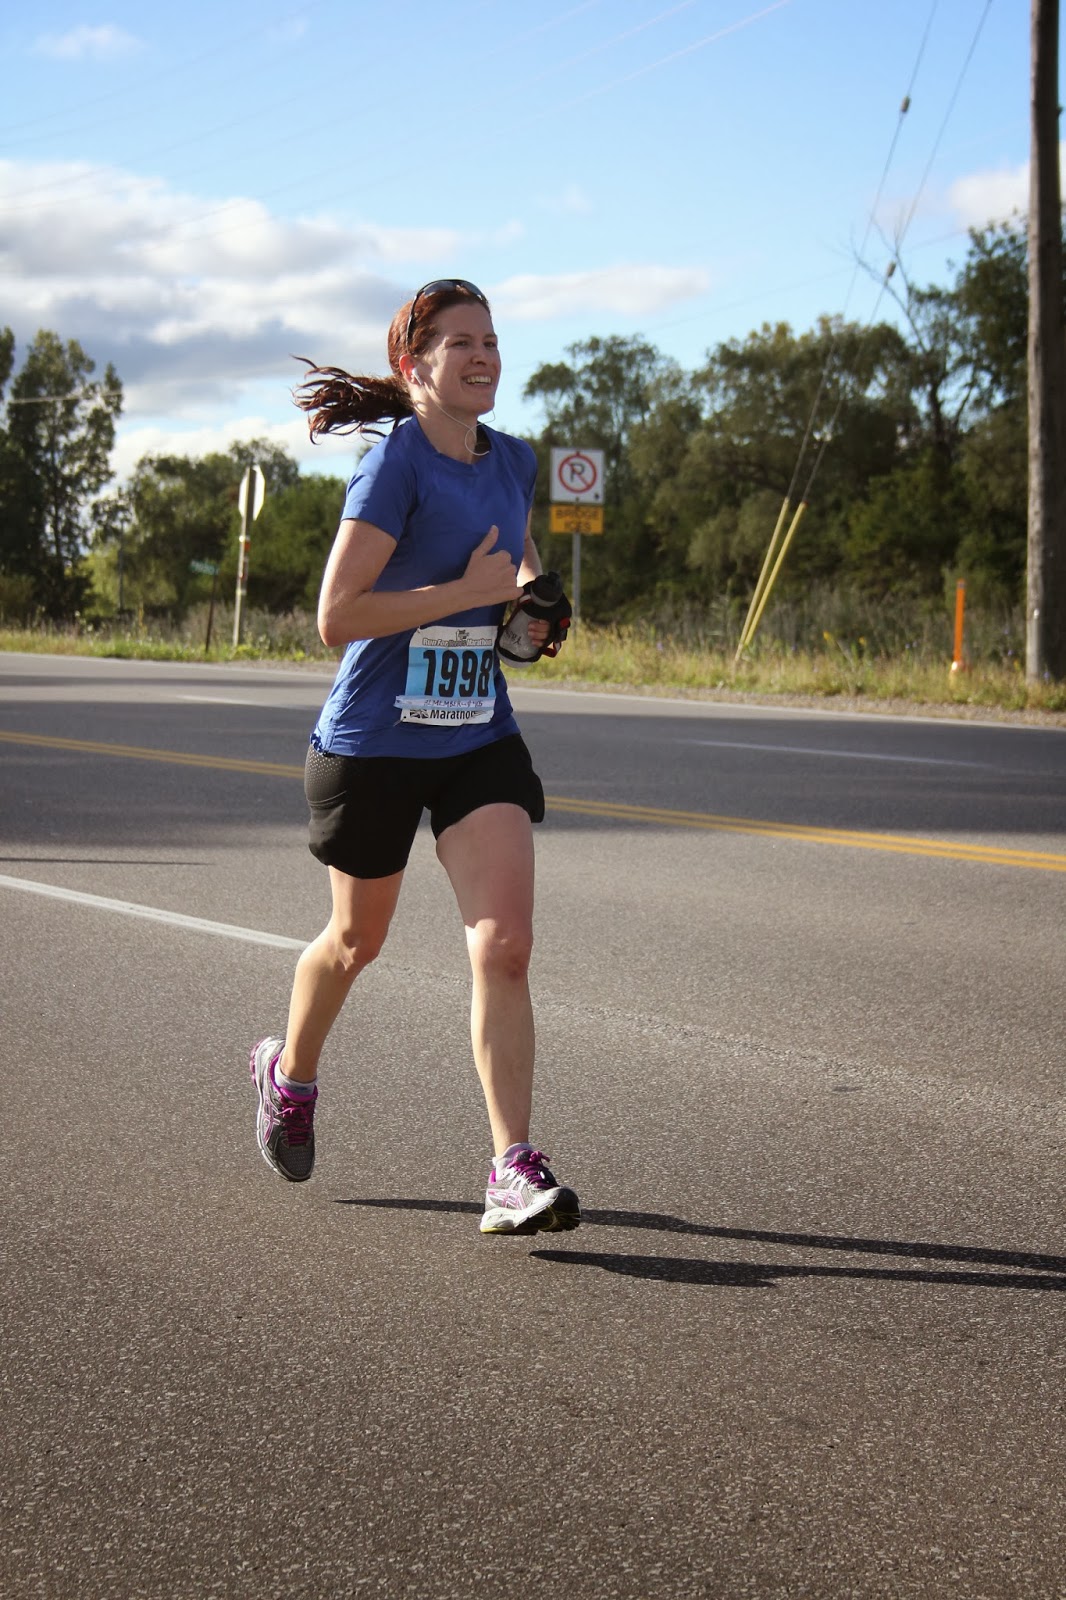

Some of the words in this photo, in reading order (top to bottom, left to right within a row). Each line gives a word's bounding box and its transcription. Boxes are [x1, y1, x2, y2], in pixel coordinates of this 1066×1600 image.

[570, 463, 586, 482] P
[555, 509, 599, 520] BRIDGE
[467, 637, 493, 646] Marathon
[423, 650, 493, 698] 1998
